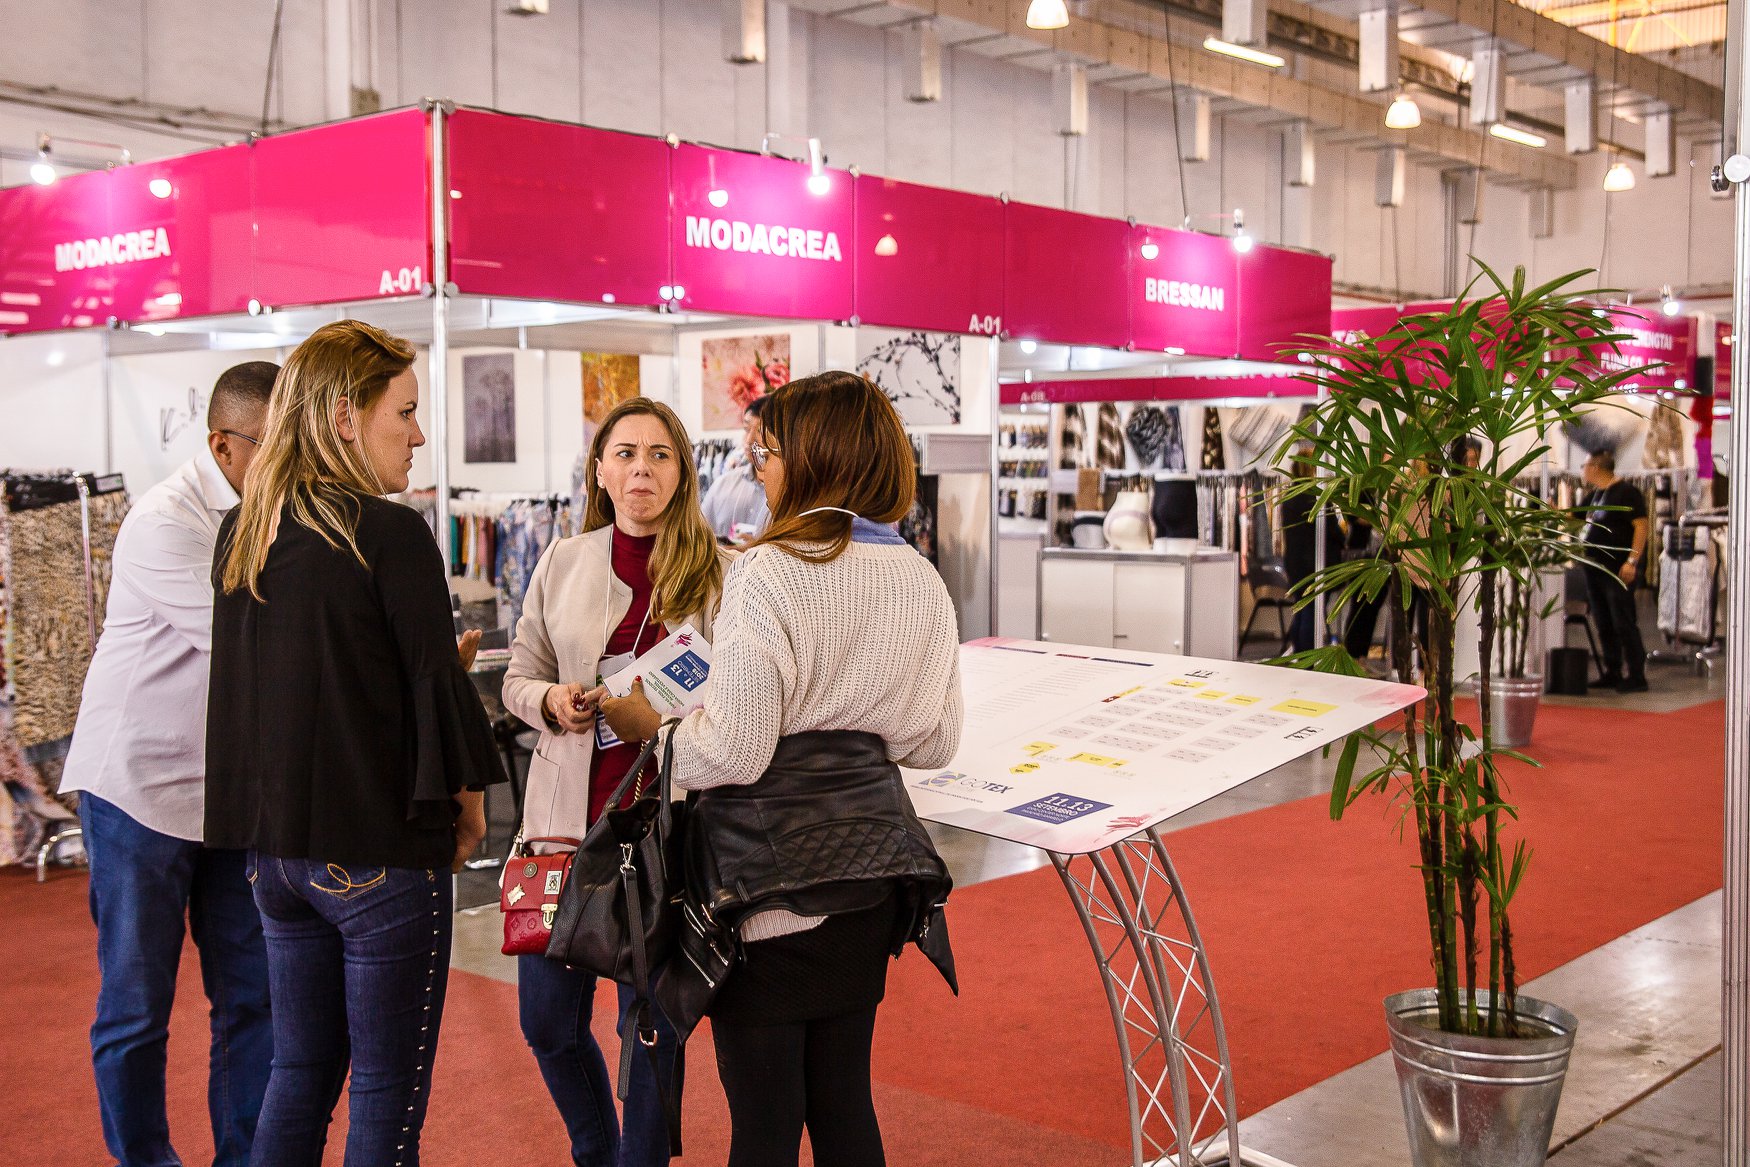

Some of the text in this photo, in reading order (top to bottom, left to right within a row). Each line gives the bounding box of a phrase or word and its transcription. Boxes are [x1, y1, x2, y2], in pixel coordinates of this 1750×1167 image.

[55, 227, 171, 272] MODACREA
[685, 216, 842, 262] MODACREA
[378, 265, 421, 295] A-01
[1145, 278, 1225, 311] BRESSAN
[968, 313, 1001, 334] A-01
[671, 664, 683, 676] 13
[684, 678, 694, 688] 11
[960, 778, 1013, 794] GOTEX
